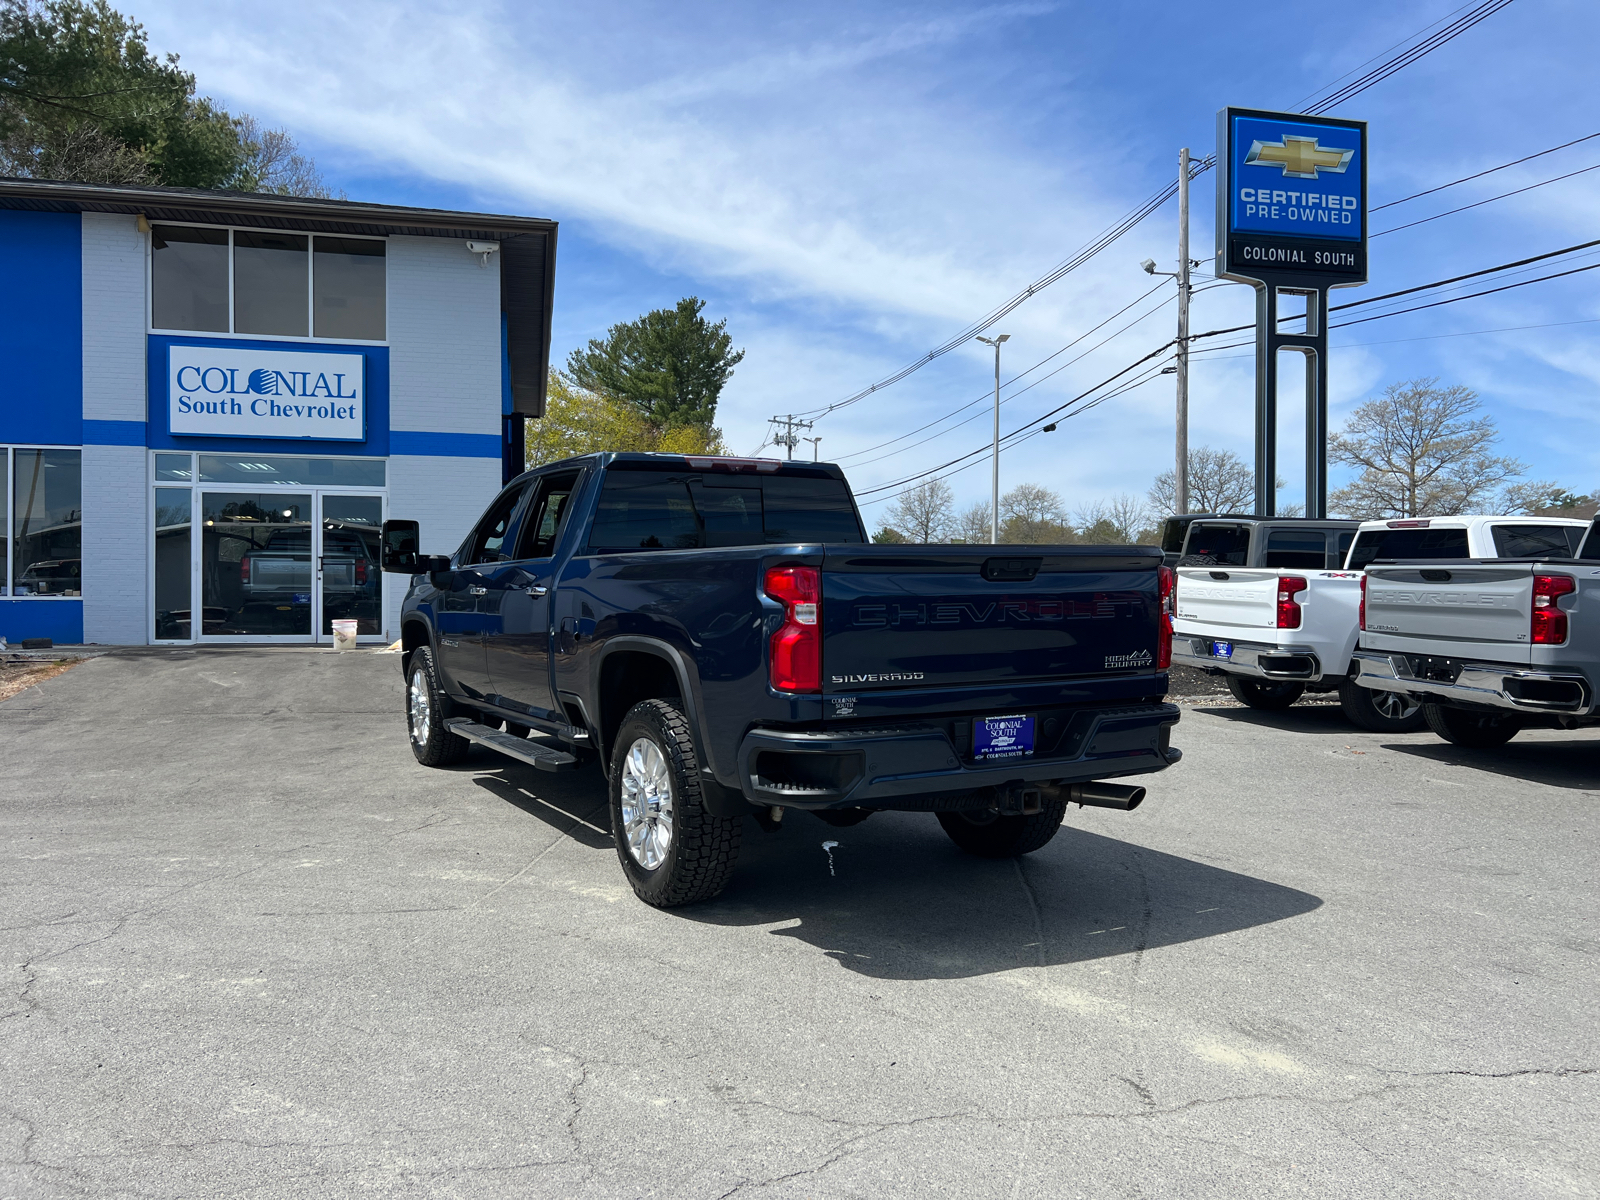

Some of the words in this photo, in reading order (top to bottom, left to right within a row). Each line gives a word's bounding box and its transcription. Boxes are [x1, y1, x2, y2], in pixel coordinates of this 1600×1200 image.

[1240, 188, 1357, 210] CERTIFIED
[1246, 204, 1352, 224] PRE-OWNED
[1243, 246, 1307, 263] COLONIAL
[1314, 251, 1355, 266] SOUTH
[176, 365, 357, 399] COLONIAL
[178, 395, 243, 415] South
[250, 398, 357, 420] Chevrolet
[1179, 586, 1267, 601] CHEVROLET
[1370, 591, 1515, 607] CHEVROLET
[852, 600, 1142, 626] CHEVROLET
[1104, 654, 1129, 662] HIGH
[1104, 659, 1153, 669] COUNTRY
[831, 672, 924, 684] SILVERADO
[985, 720, 1023, 731] COLONIAL
[990, 728, 1017, 738] SOUTH
